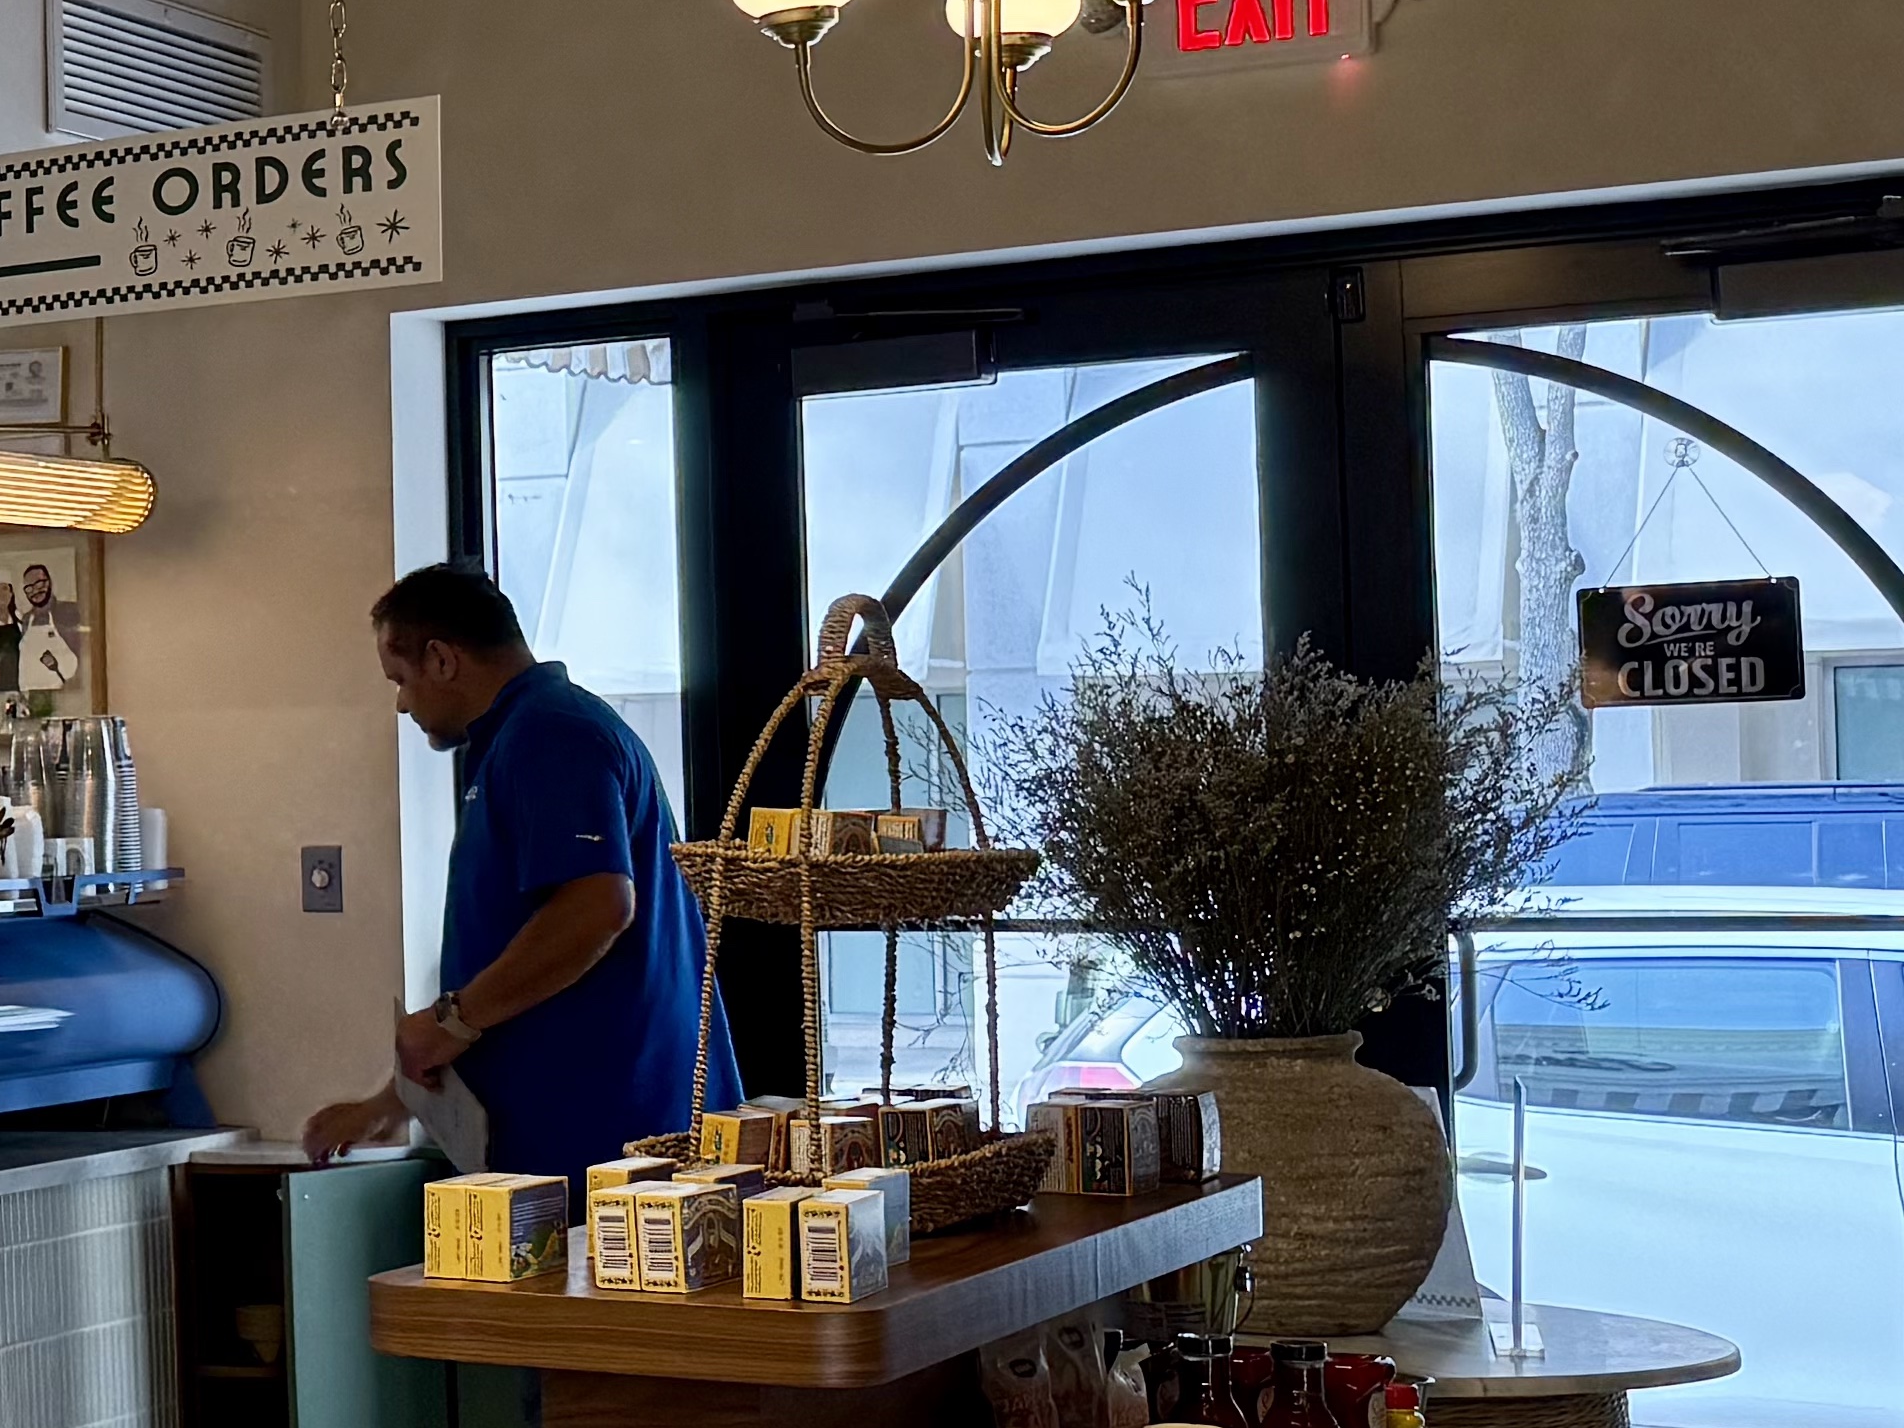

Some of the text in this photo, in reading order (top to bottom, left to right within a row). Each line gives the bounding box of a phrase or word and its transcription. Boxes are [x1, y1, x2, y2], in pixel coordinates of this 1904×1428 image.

[151, 138, 408, 217] ORDERS
[1617, 593, 1762, 648] Sorry
[1663, 641, 1716, 657] WE'RE
[1617, 656, 1765, 698] CLOSED
